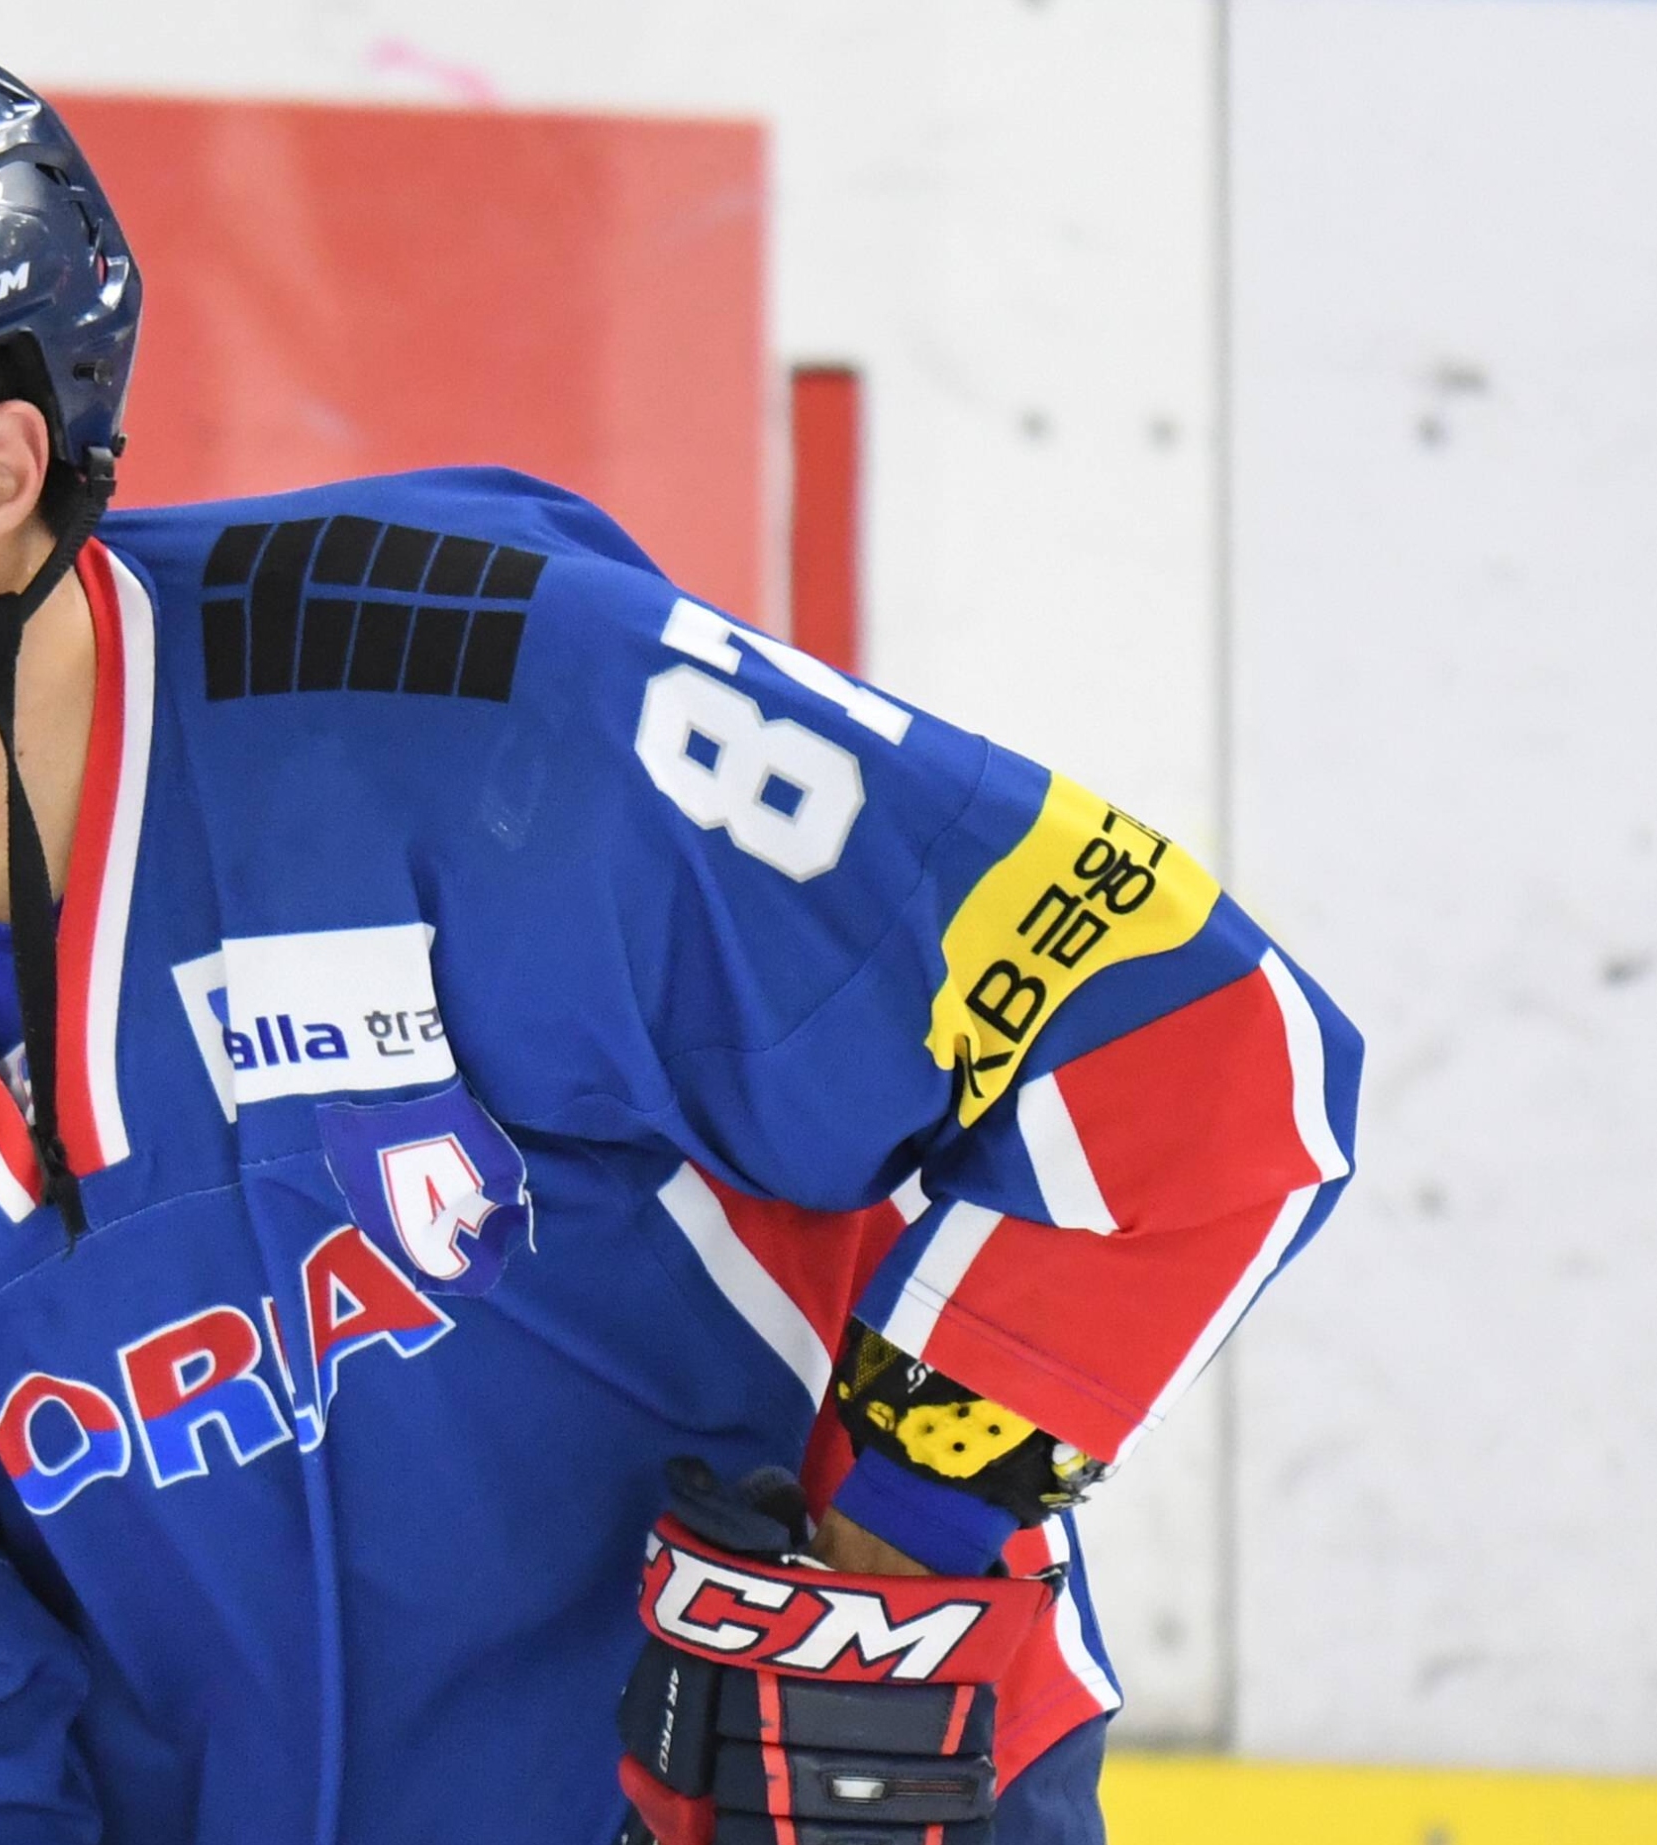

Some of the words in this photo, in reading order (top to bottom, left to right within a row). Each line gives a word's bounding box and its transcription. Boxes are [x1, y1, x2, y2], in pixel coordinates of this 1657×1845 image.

[635, 597, 913, 883] 87
[377, 1132, 497, 1281] A
[645, 1530, 984, 1681] CM
[659, 1709, 675, 1774] PRO
